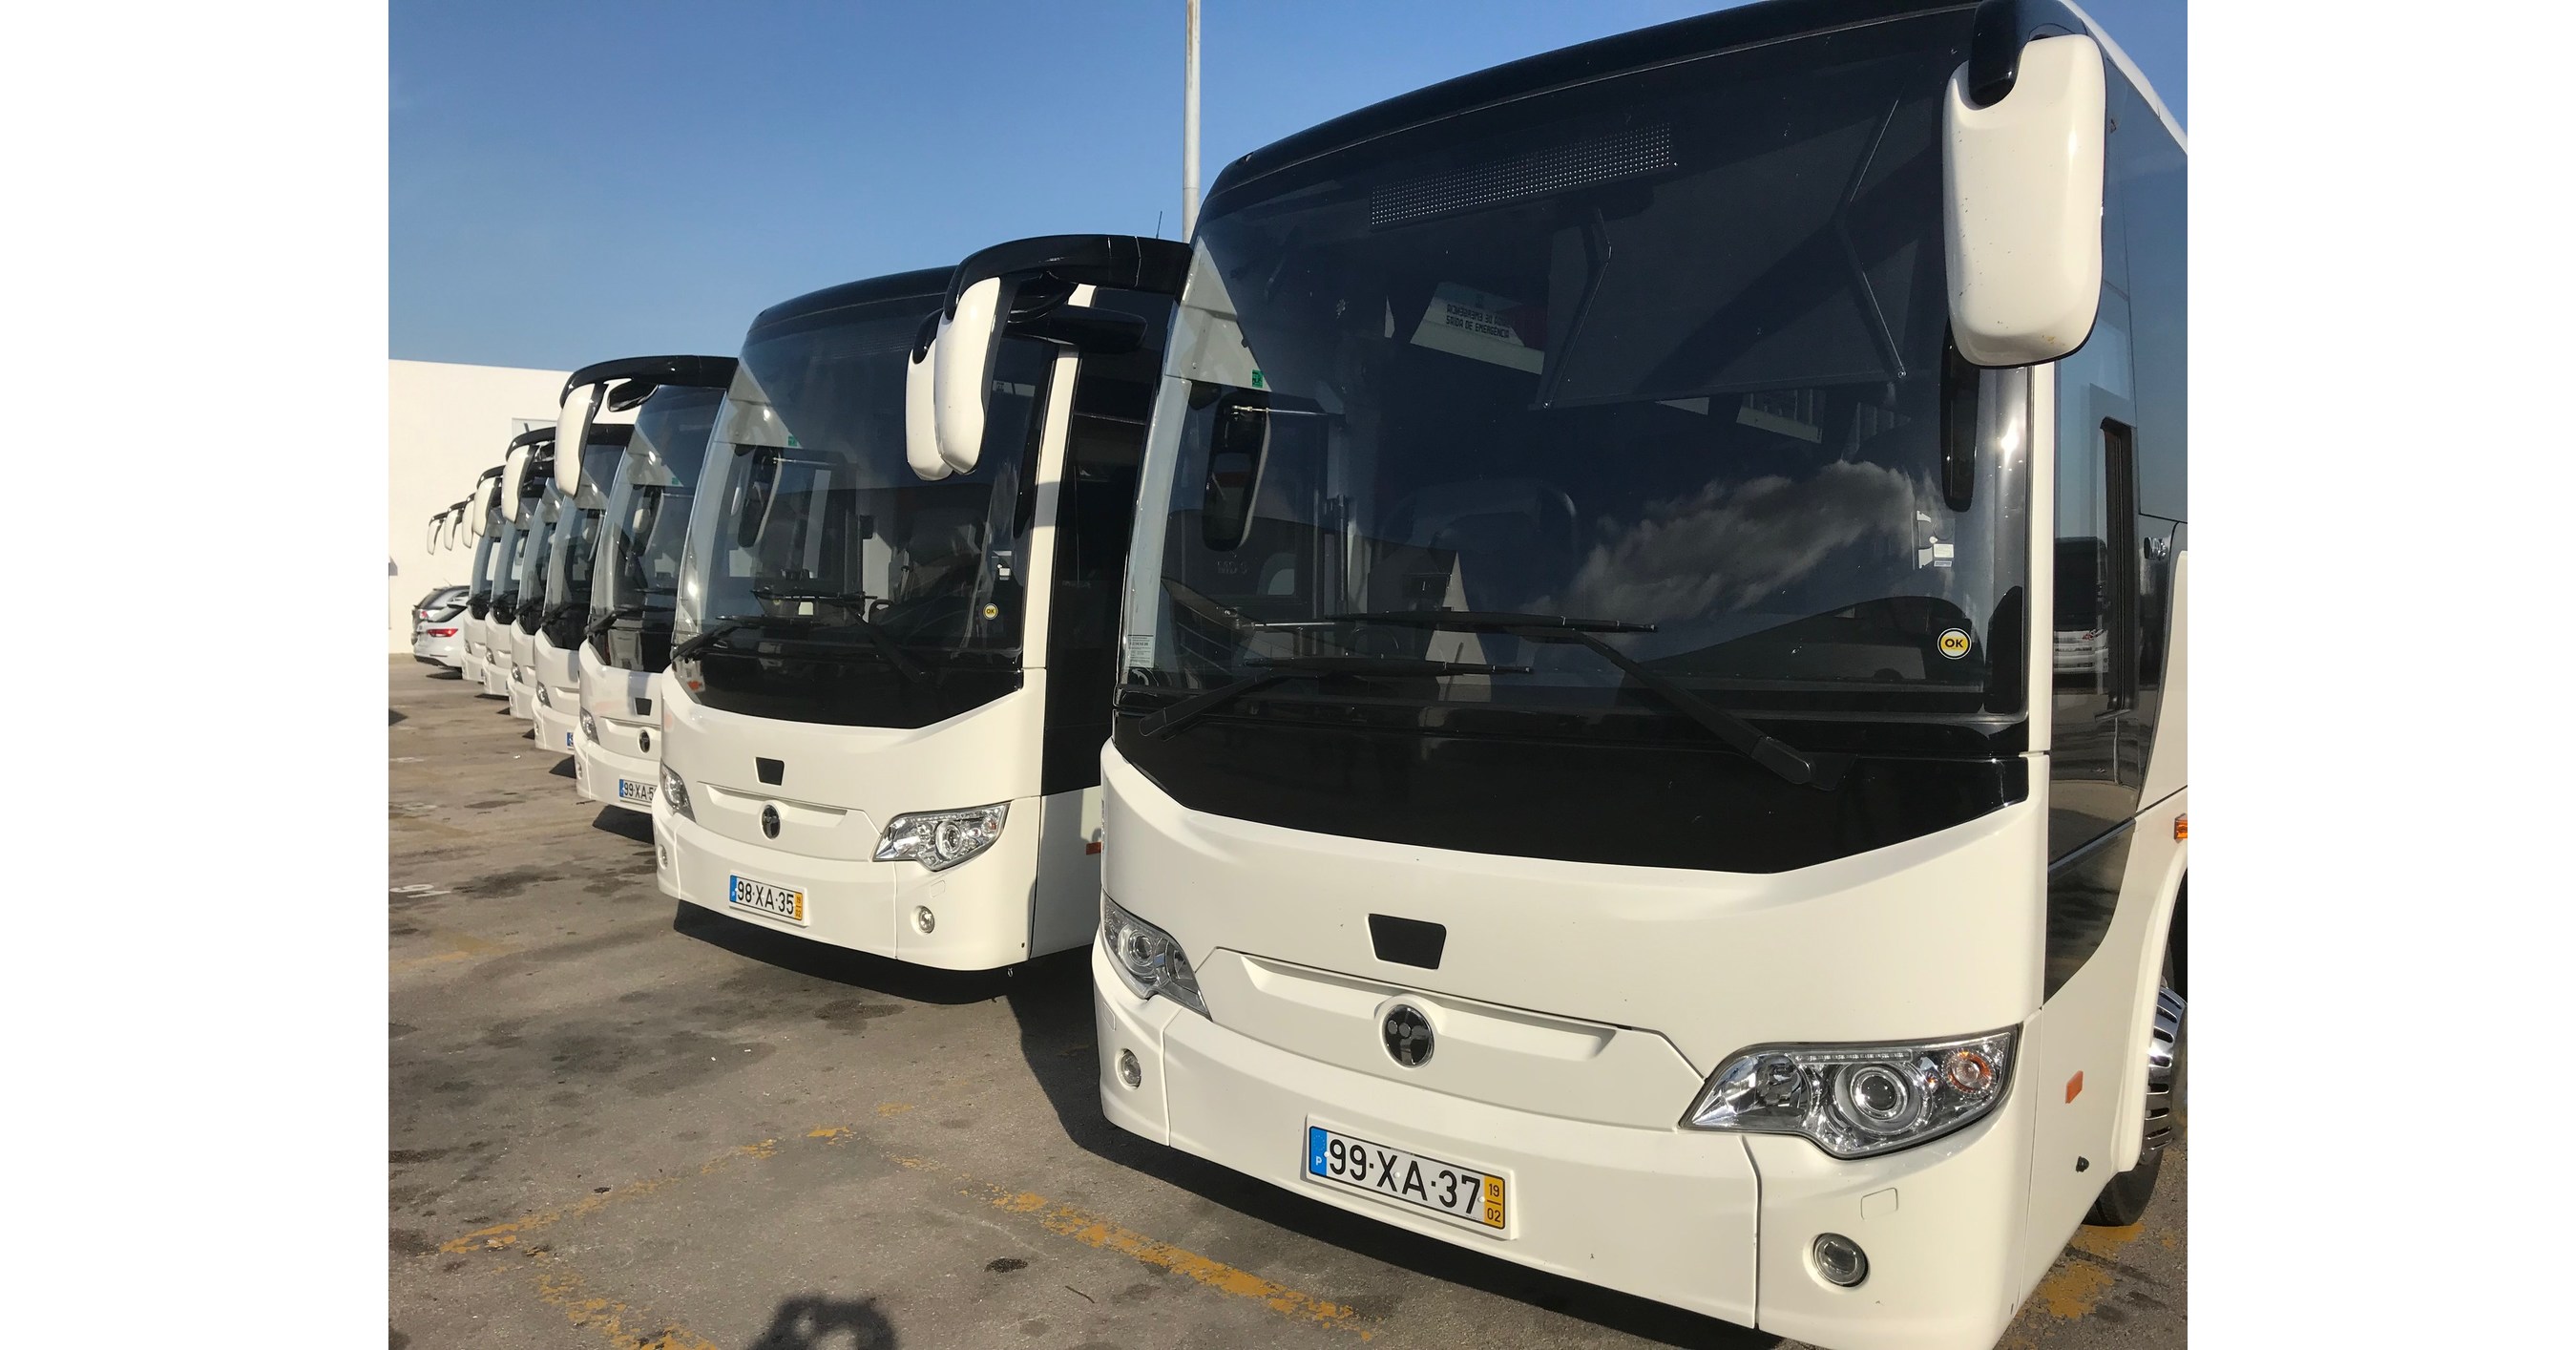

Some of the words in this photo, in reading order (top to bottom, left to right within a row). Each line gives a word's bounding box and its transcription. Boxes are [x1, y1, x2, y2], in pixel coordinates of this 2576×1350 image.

[1944, 639, 1964, 648] OK
[624, 782, 656, 801] 99·XA·5
[1315, 1155, 1323, 1166] P
[1488, 1183, 1500, 1197] 19
[1487, 1208, 1501, 1223] 02
